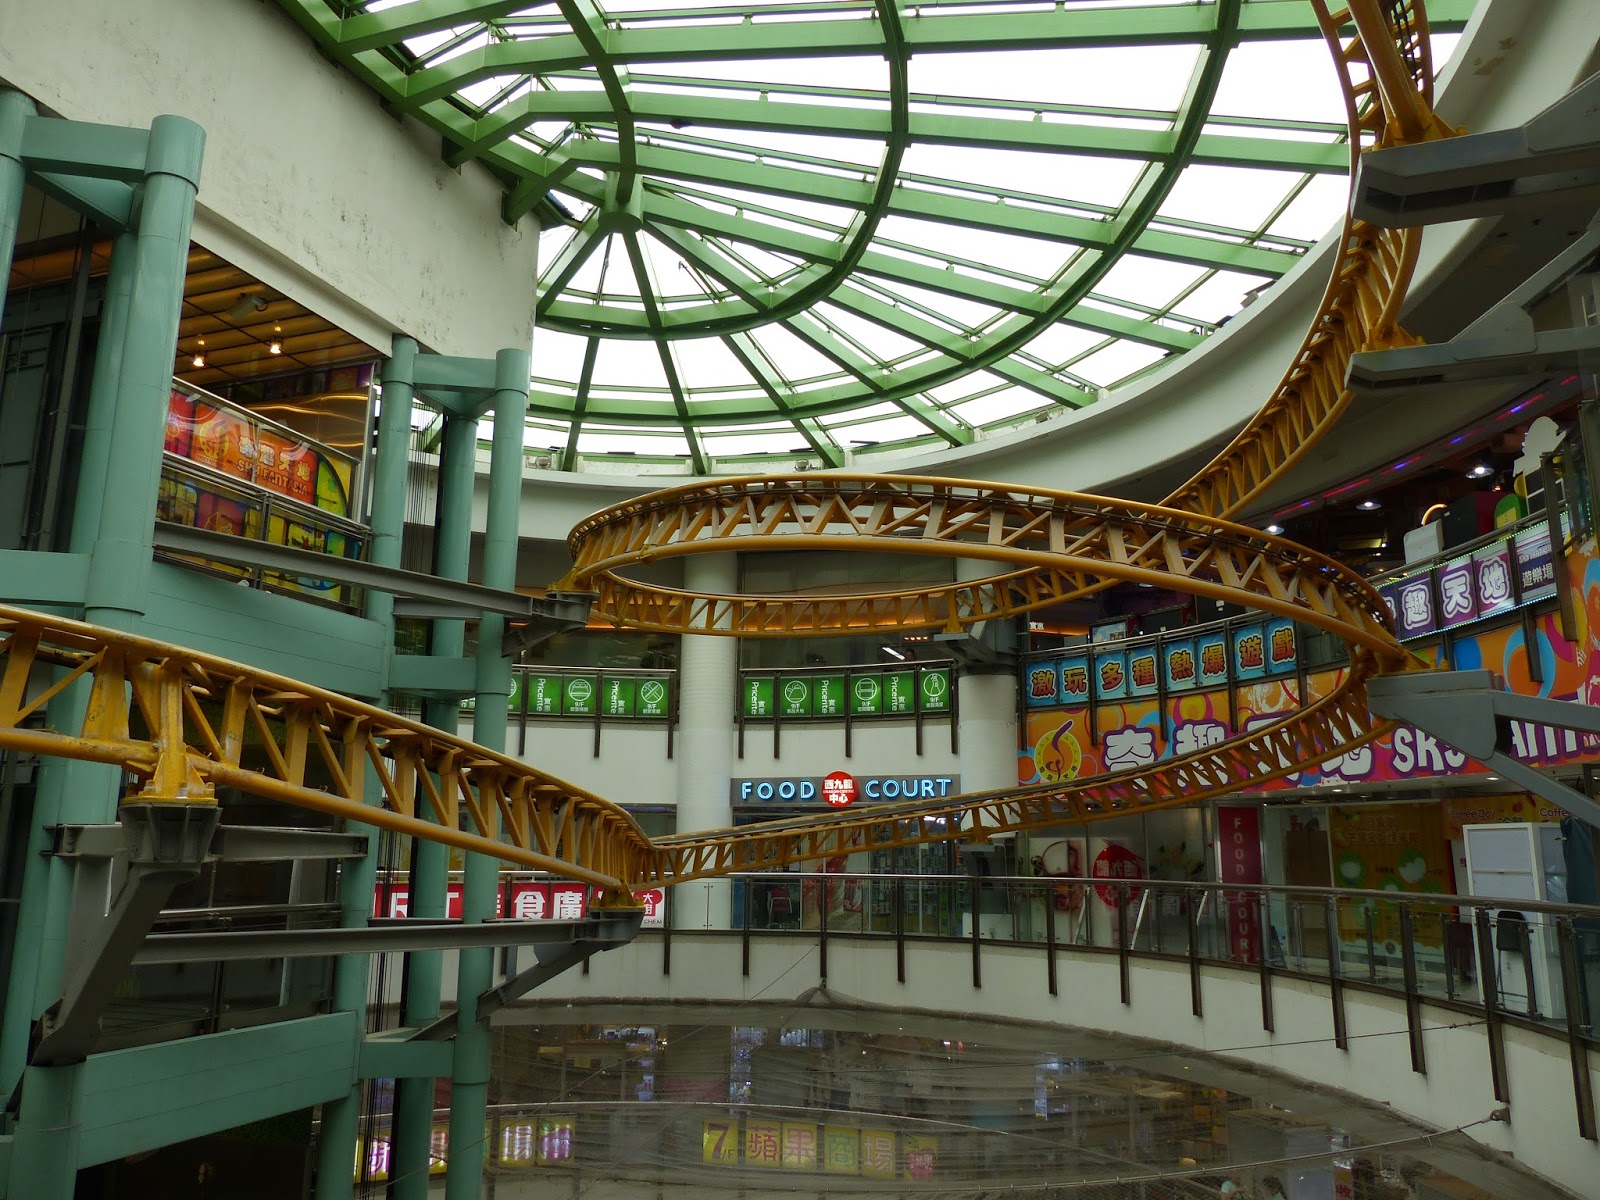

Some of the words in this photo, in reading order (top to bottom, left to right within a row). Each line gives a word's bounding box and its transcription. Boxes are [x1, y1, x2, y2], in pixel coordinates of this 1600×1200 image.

[1522, 563, 1554, 588] 遊樂場
[1386, 556, 1511, 630] 趣天地
[742, 782, 815, 800] FOOD
[865, 778, 951, 798] COURT
[824, 779, 853, 789] 西九龍
[829, 794, 848, 803] 中心
[1233, 818, 1244, 875] FOOD
[707, 1122, 734, 1160] 7/F
